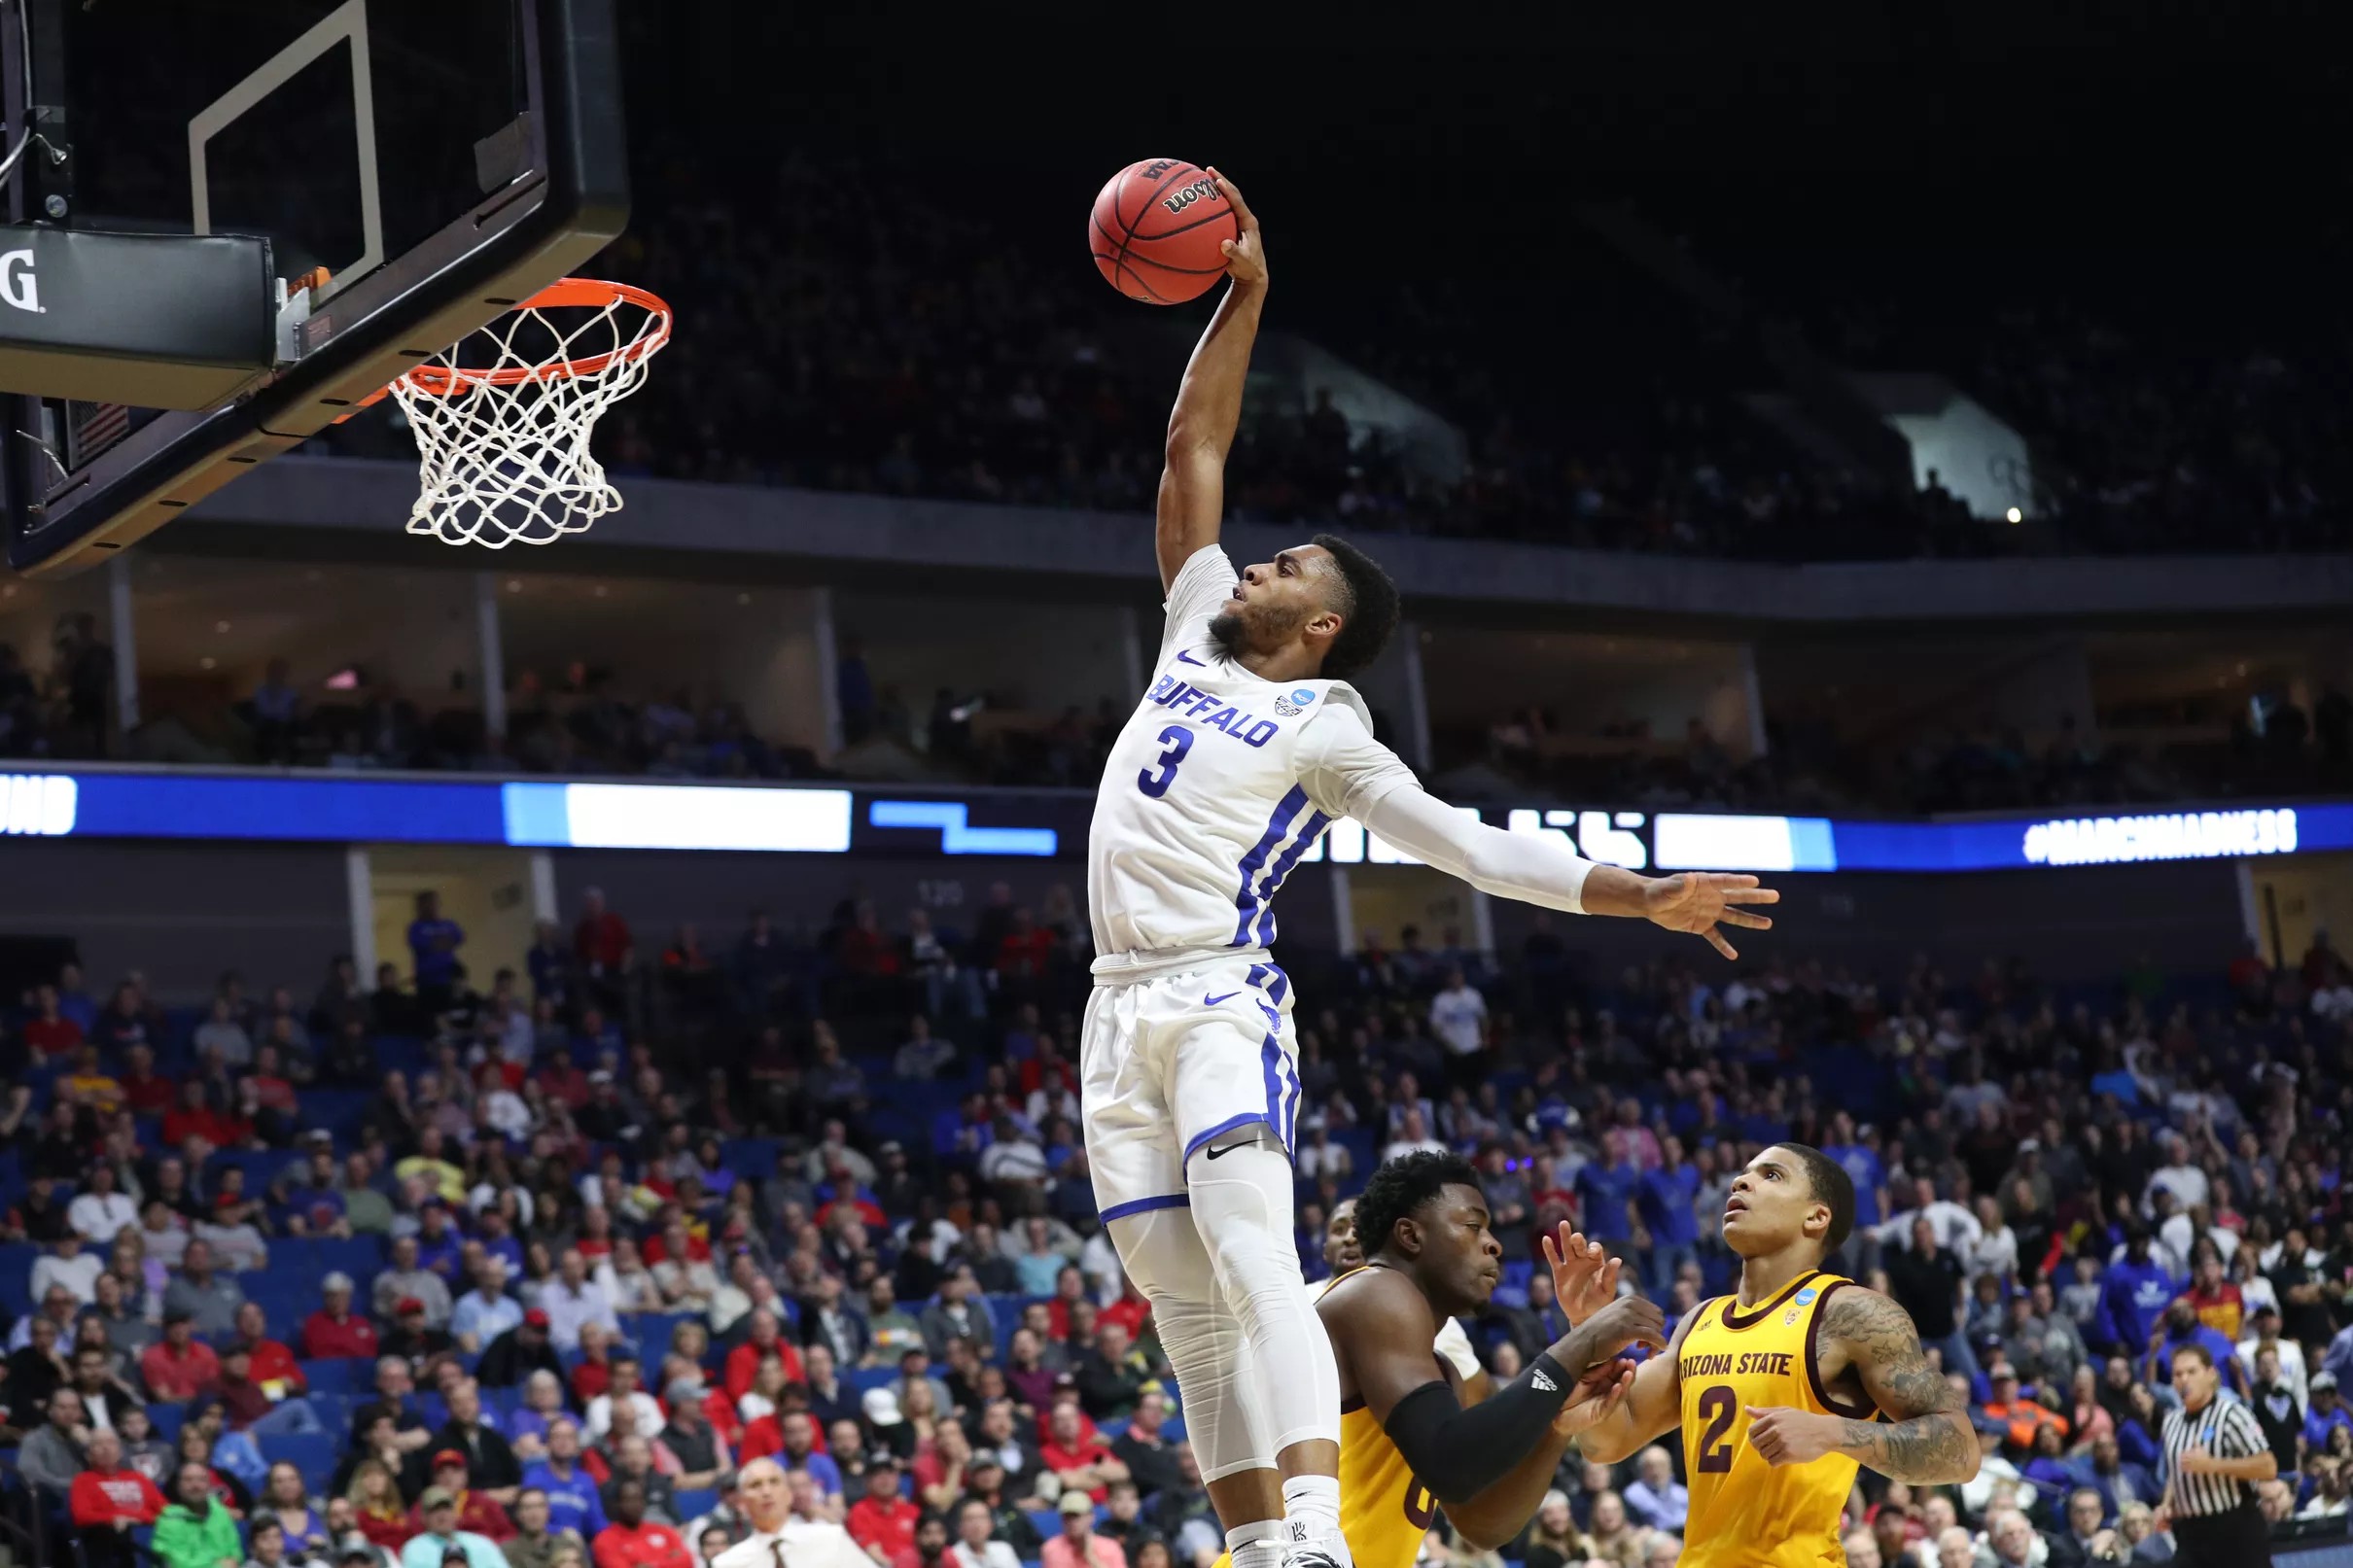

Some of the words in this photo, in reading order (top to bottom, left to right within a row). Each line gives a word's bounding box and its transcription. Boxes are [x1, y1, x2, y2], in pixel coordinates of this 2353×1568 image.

[1163, 178, 1221, 214] lson
[0, 249, 39, 312] G
[1146, 675, 1279, 748] BUFFALO
[1138, 725, 1194, 798] 3
[1737, 1352, 1794, 1376] STATE
[1698, 1385, 1737, 1473] 2
